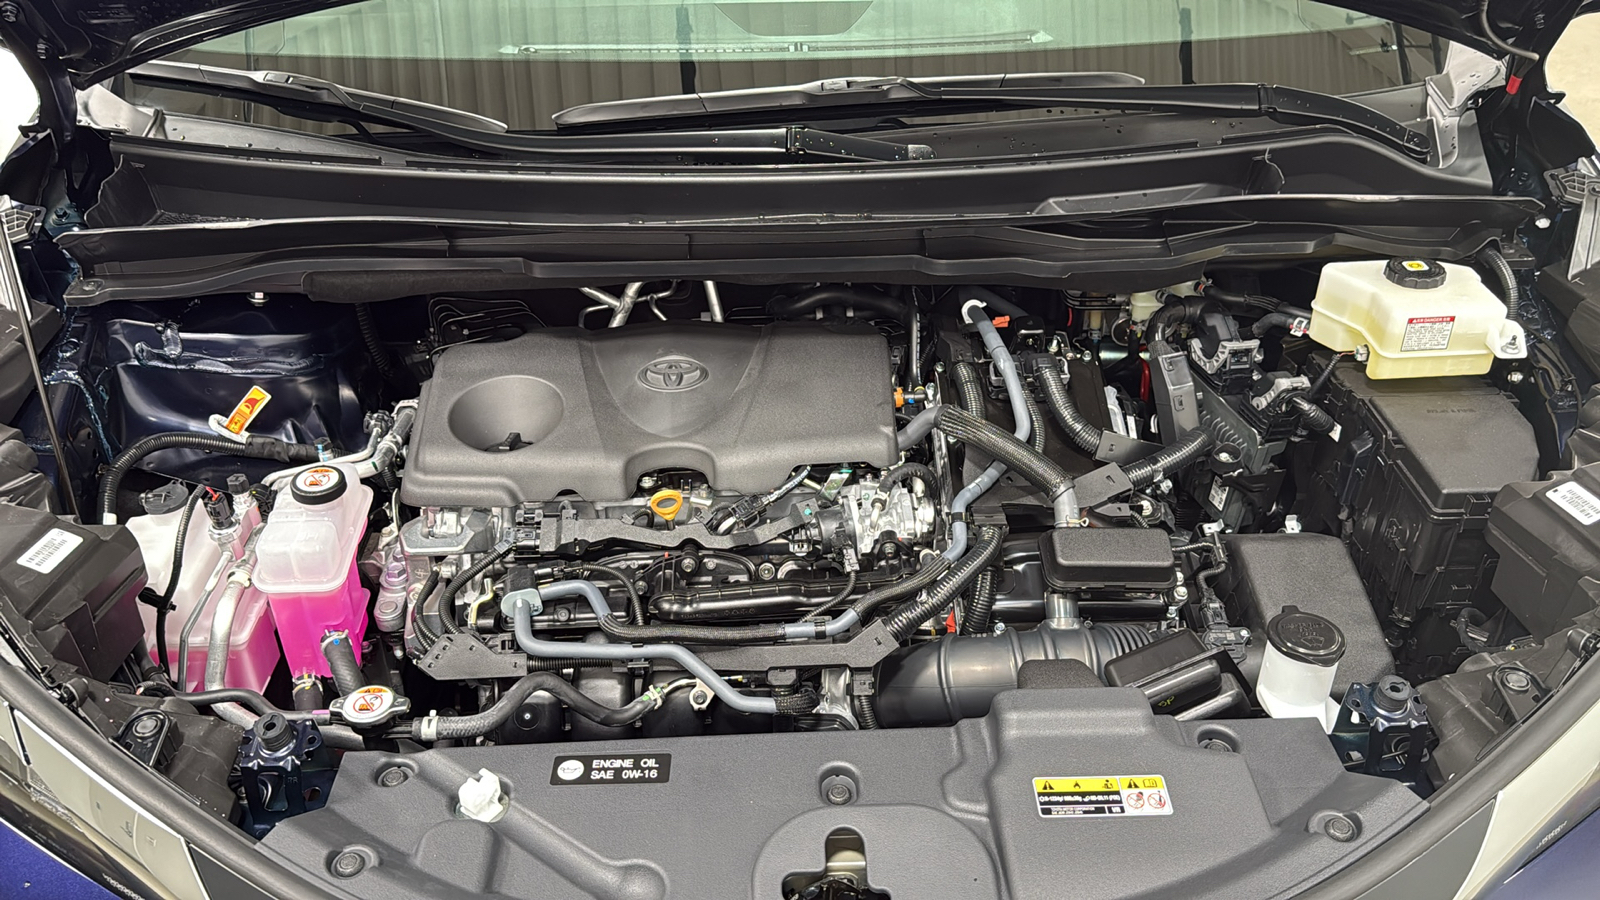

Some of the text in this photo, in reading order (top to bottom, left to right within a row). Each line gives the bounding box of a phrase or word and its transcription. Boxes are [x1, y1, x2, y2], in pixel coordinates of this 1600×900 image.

[592, 758, 660, 768] ENGINE OIL
[590, 769, 658, 779] SAE 0W-16
